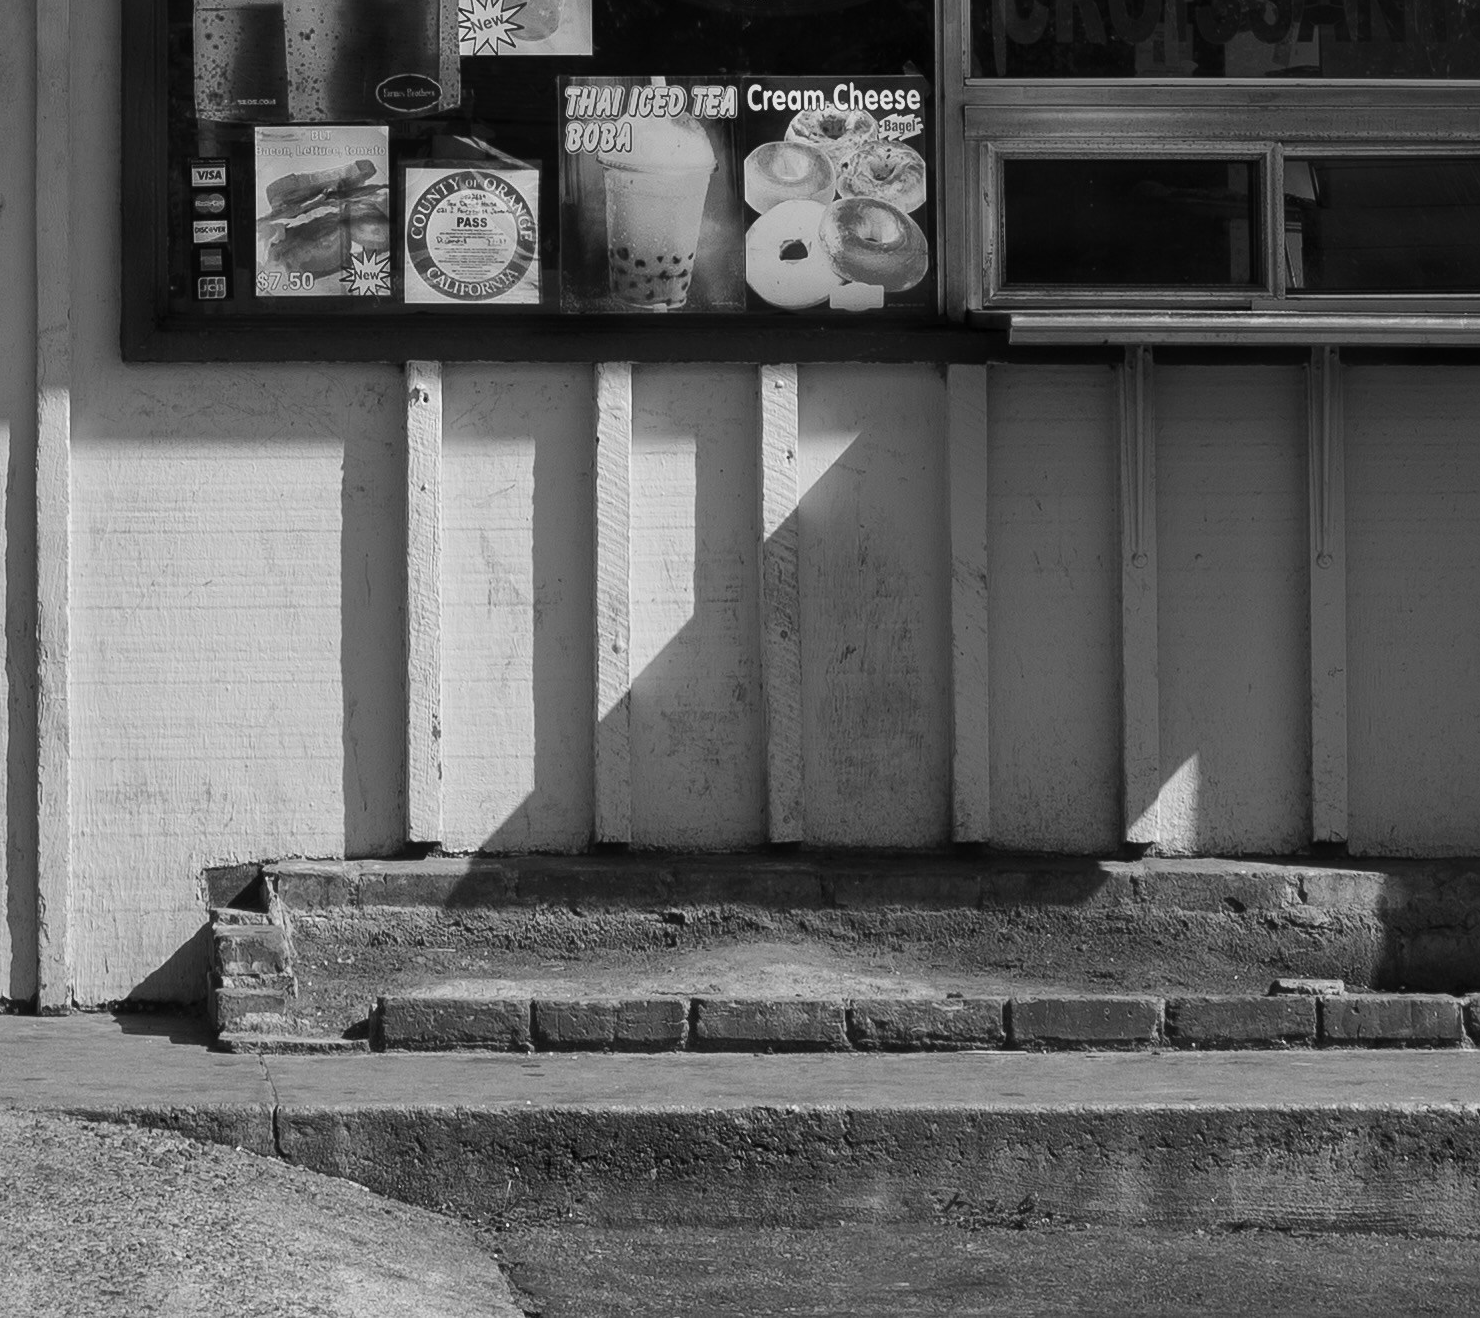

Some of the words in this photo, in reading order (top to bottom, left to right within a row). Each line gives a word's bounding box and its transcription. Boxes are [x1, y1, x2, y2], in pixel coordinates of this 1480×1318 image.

[470, 14, 505, 34] New
[565, 86, 626, 119] THAI
[628, 85, 690, 119] ICED
[690, 85, 739, 119] TEA
[746, 84, 826, 112] Cream
[832, 81, 921, 112] Cheese
[884, 118, 918, 134] Bagel
[310, 129, 334, 142] BLT
[565, 121, 635, 154] BOBA
[255, 146, 293, 158] Bacon,
[296, 146, 343, 158] Lettuce,
[344, 146, 387, 157] tomato
[196, 169, 224, 181] VISA
[411, 176, 460, 240] COUNTY
[483, 178, 534, 243] ORANGE
[194, 225, 226, 234] DISCOVER
[456, 216, 488, 228] PASS
[257, 271, 316, 292] $7.50
[355, 269, 380, 282] New
[427, 266, 519, 297] CALIFORNIA
